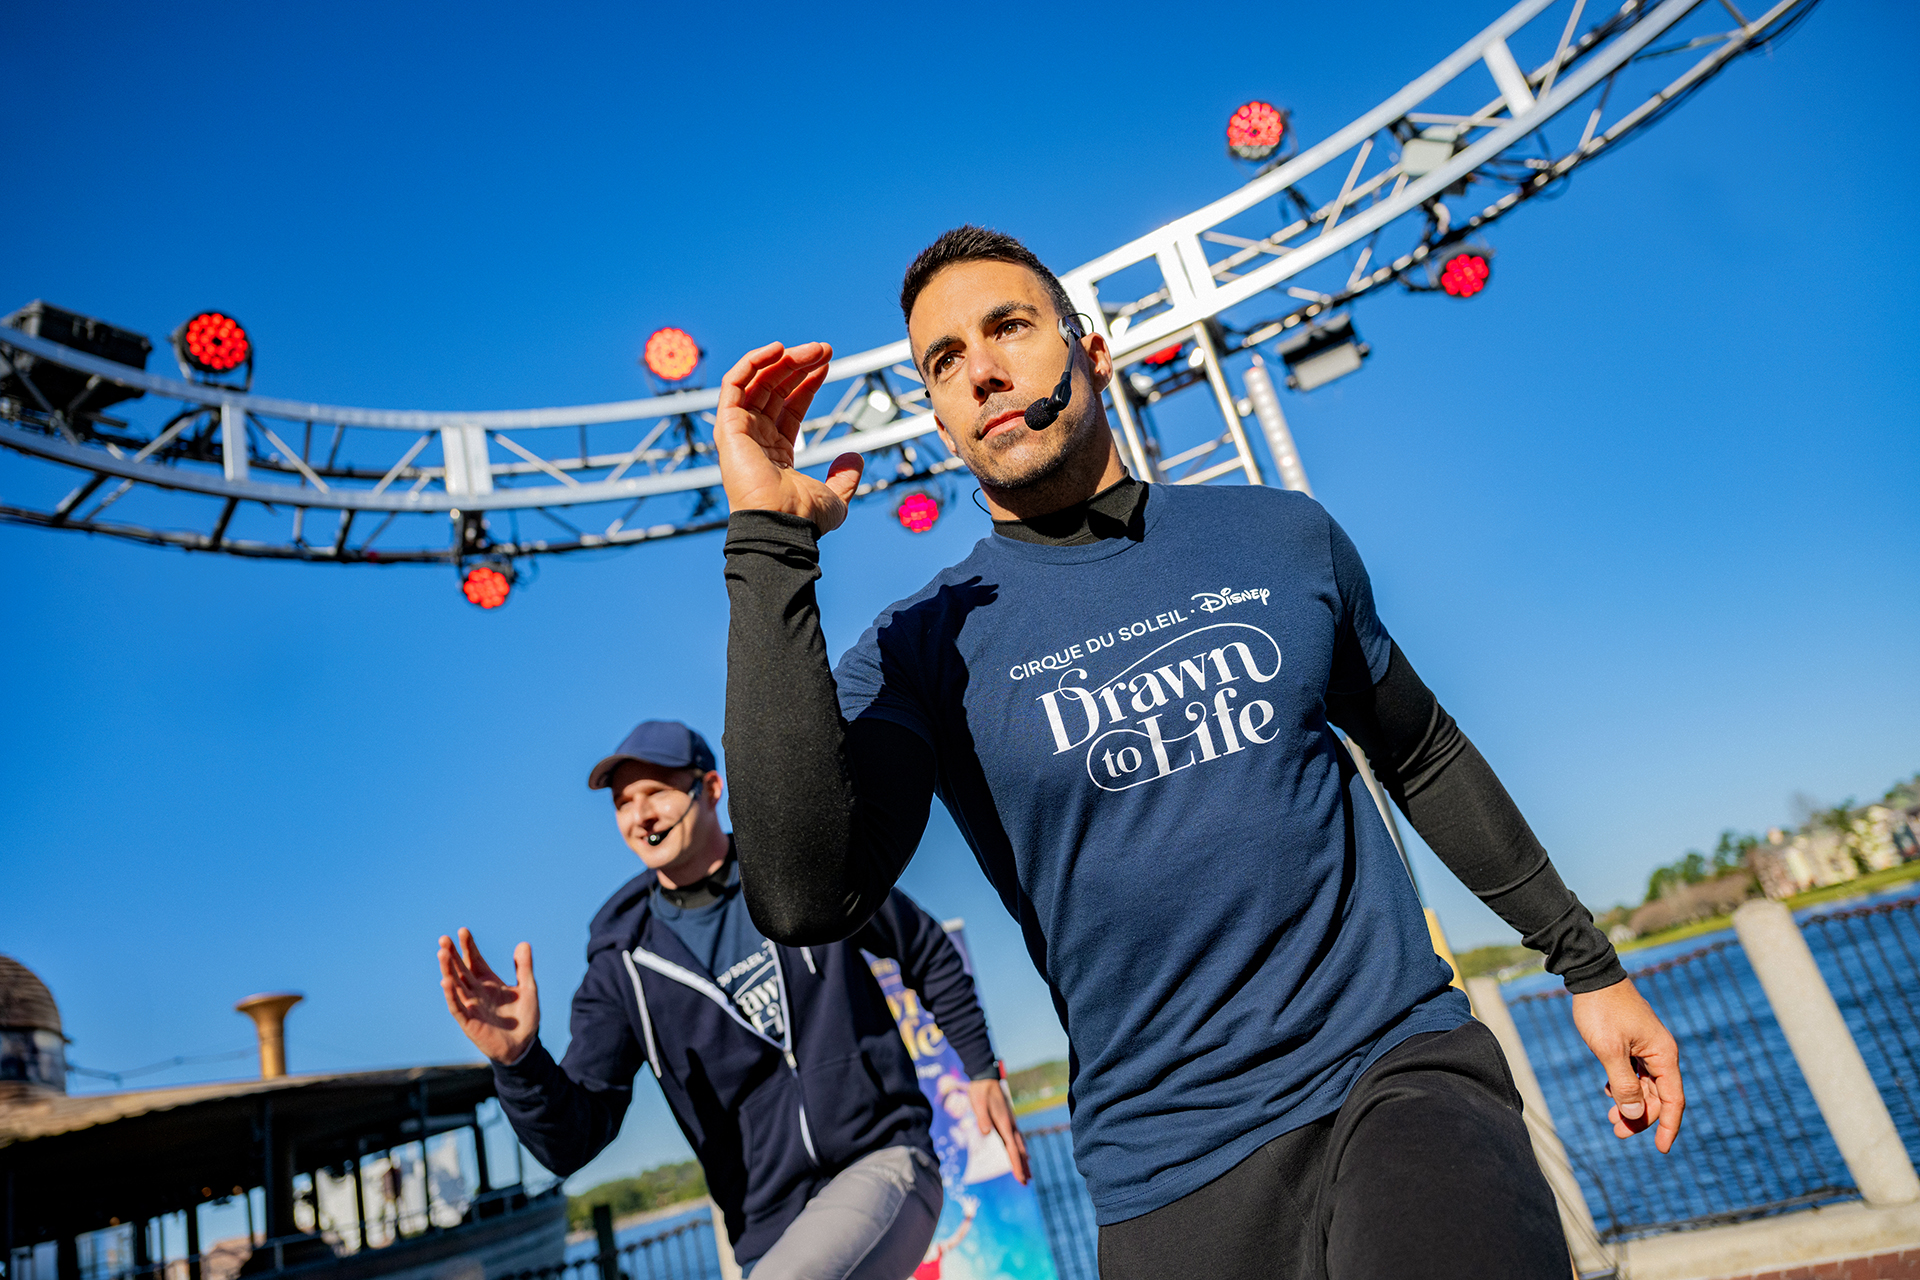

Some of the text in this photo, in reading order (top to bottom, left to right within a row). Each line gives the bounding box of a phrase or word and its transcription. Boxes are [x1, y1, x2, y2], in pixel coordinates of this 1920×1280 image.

[1009, 587, 1270, 681] CIRQUE DU SOLEIL Disney
[1035, 622, 1282, 756] Drawn
[1101, 687, 1280, 778] to Life
